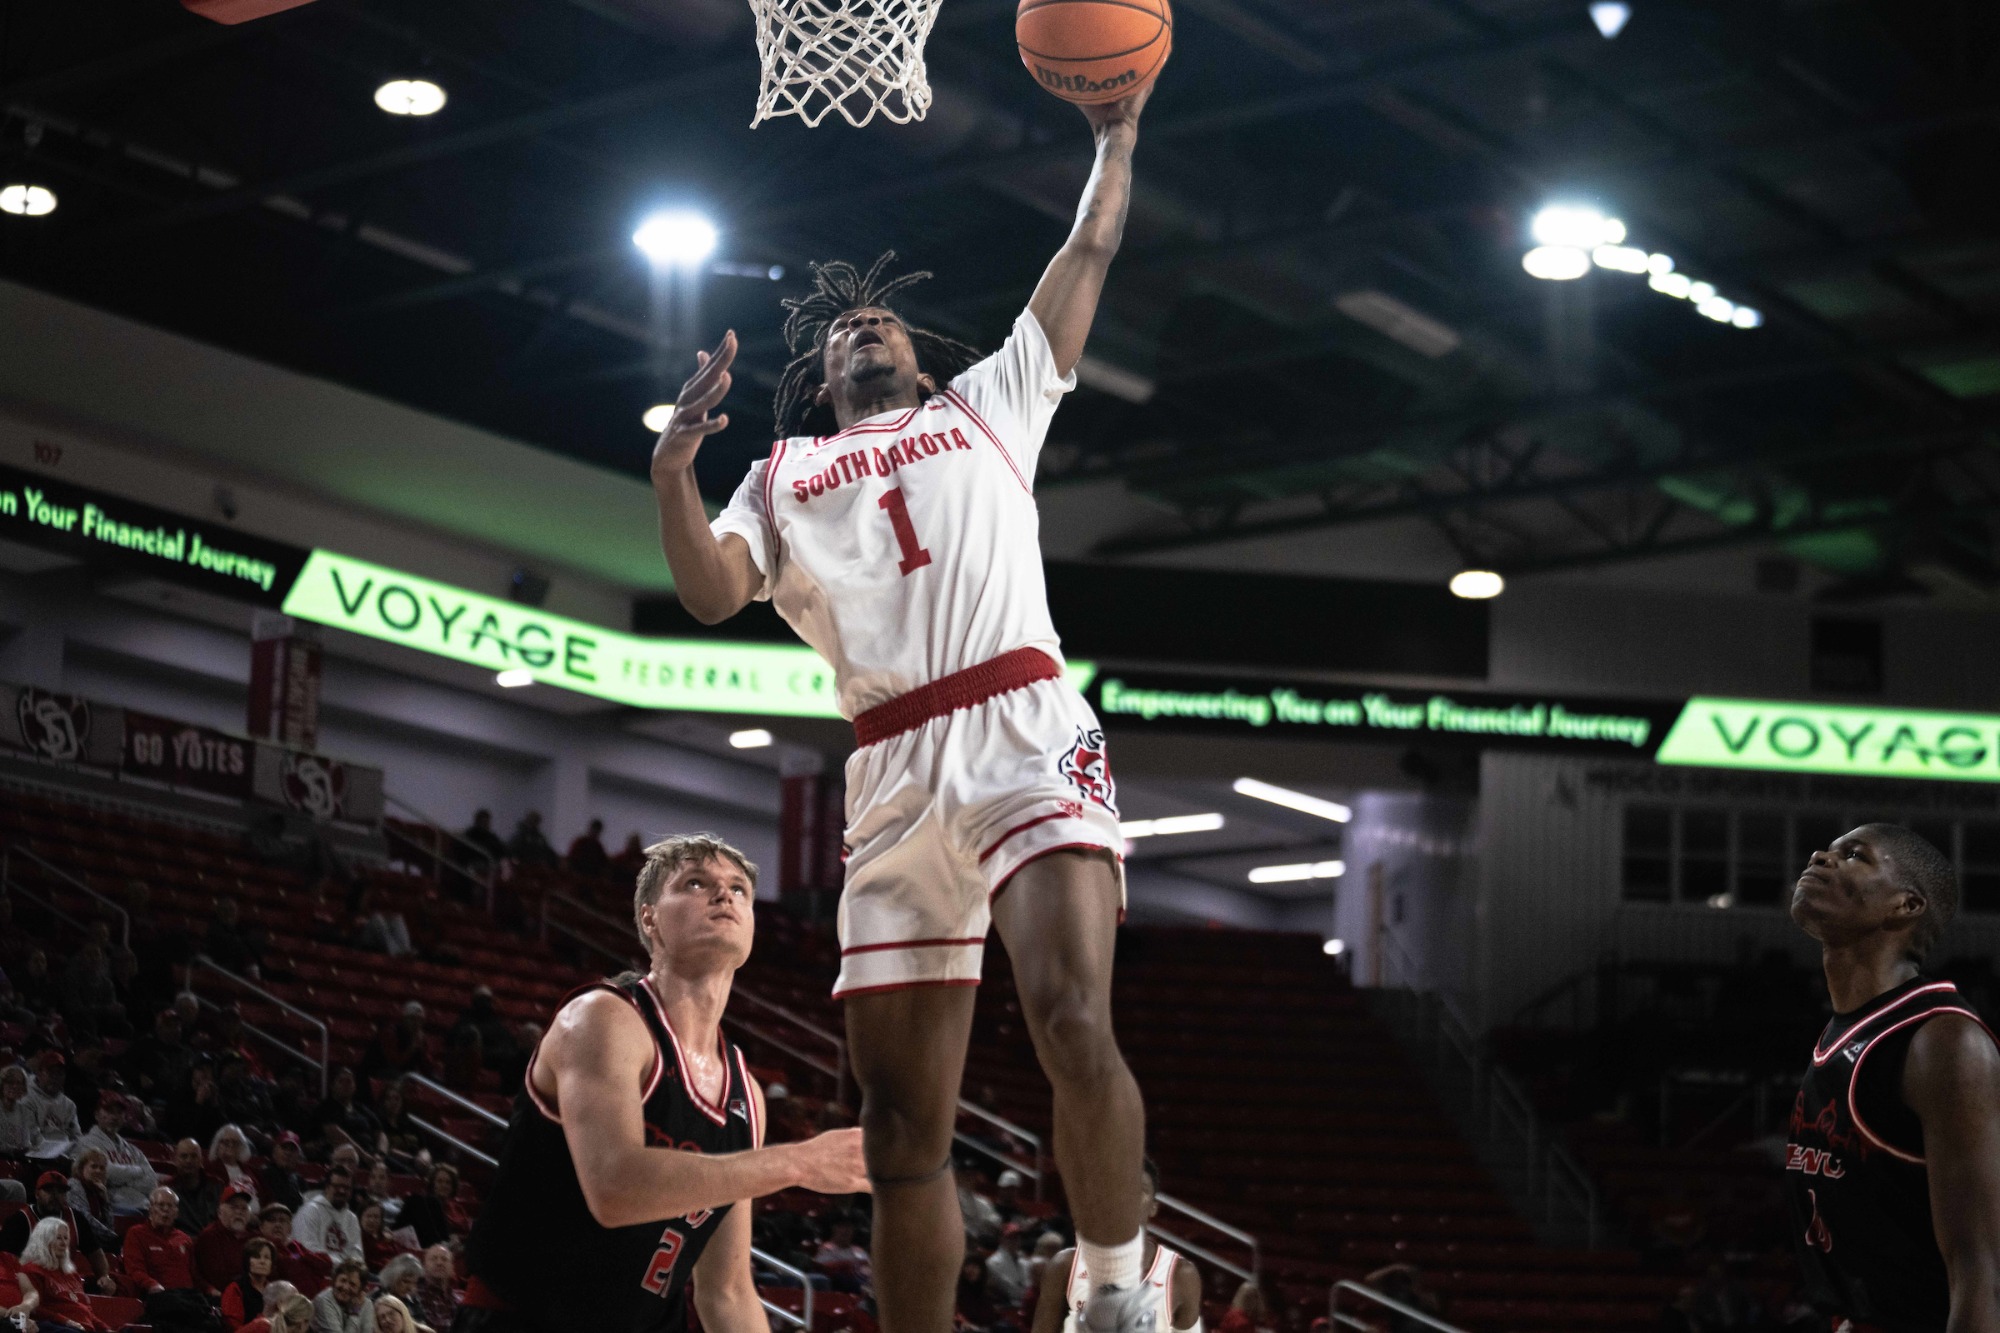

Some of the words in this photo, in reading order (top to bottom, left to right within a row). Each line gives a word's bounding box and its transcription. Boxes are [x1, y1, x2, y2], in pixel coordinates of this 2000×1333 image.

[1034, 63, 1138, 93] Wilson
[792, 450, 872, 504] SOUTH
[872, 427, 972, 478] DAKOTA
[24, 486, 78, 531] Your
[82, 502, 186, 562] Financial
[187, 532, 277, 592] Journey
[878, 486, 932, 577] 1
[329, 566, 598, 682] VOYAGE
[622, 658, 763, 692] FEDERAL
[1101, 678, 1271, 728] Empowering
[1269, 686, 1323, 725] You
[1323, 699, 1362, 727] on
[1361, 692, 1425, 729] Your
[1426, 695, 1548, 737] Financial
[1546, 703, 1651, 748] Journey
[1710, 714, 2000, 768] VOYAG
[133, 732, 164, 766] GO
[172, 730, 245, 776] YOTES
